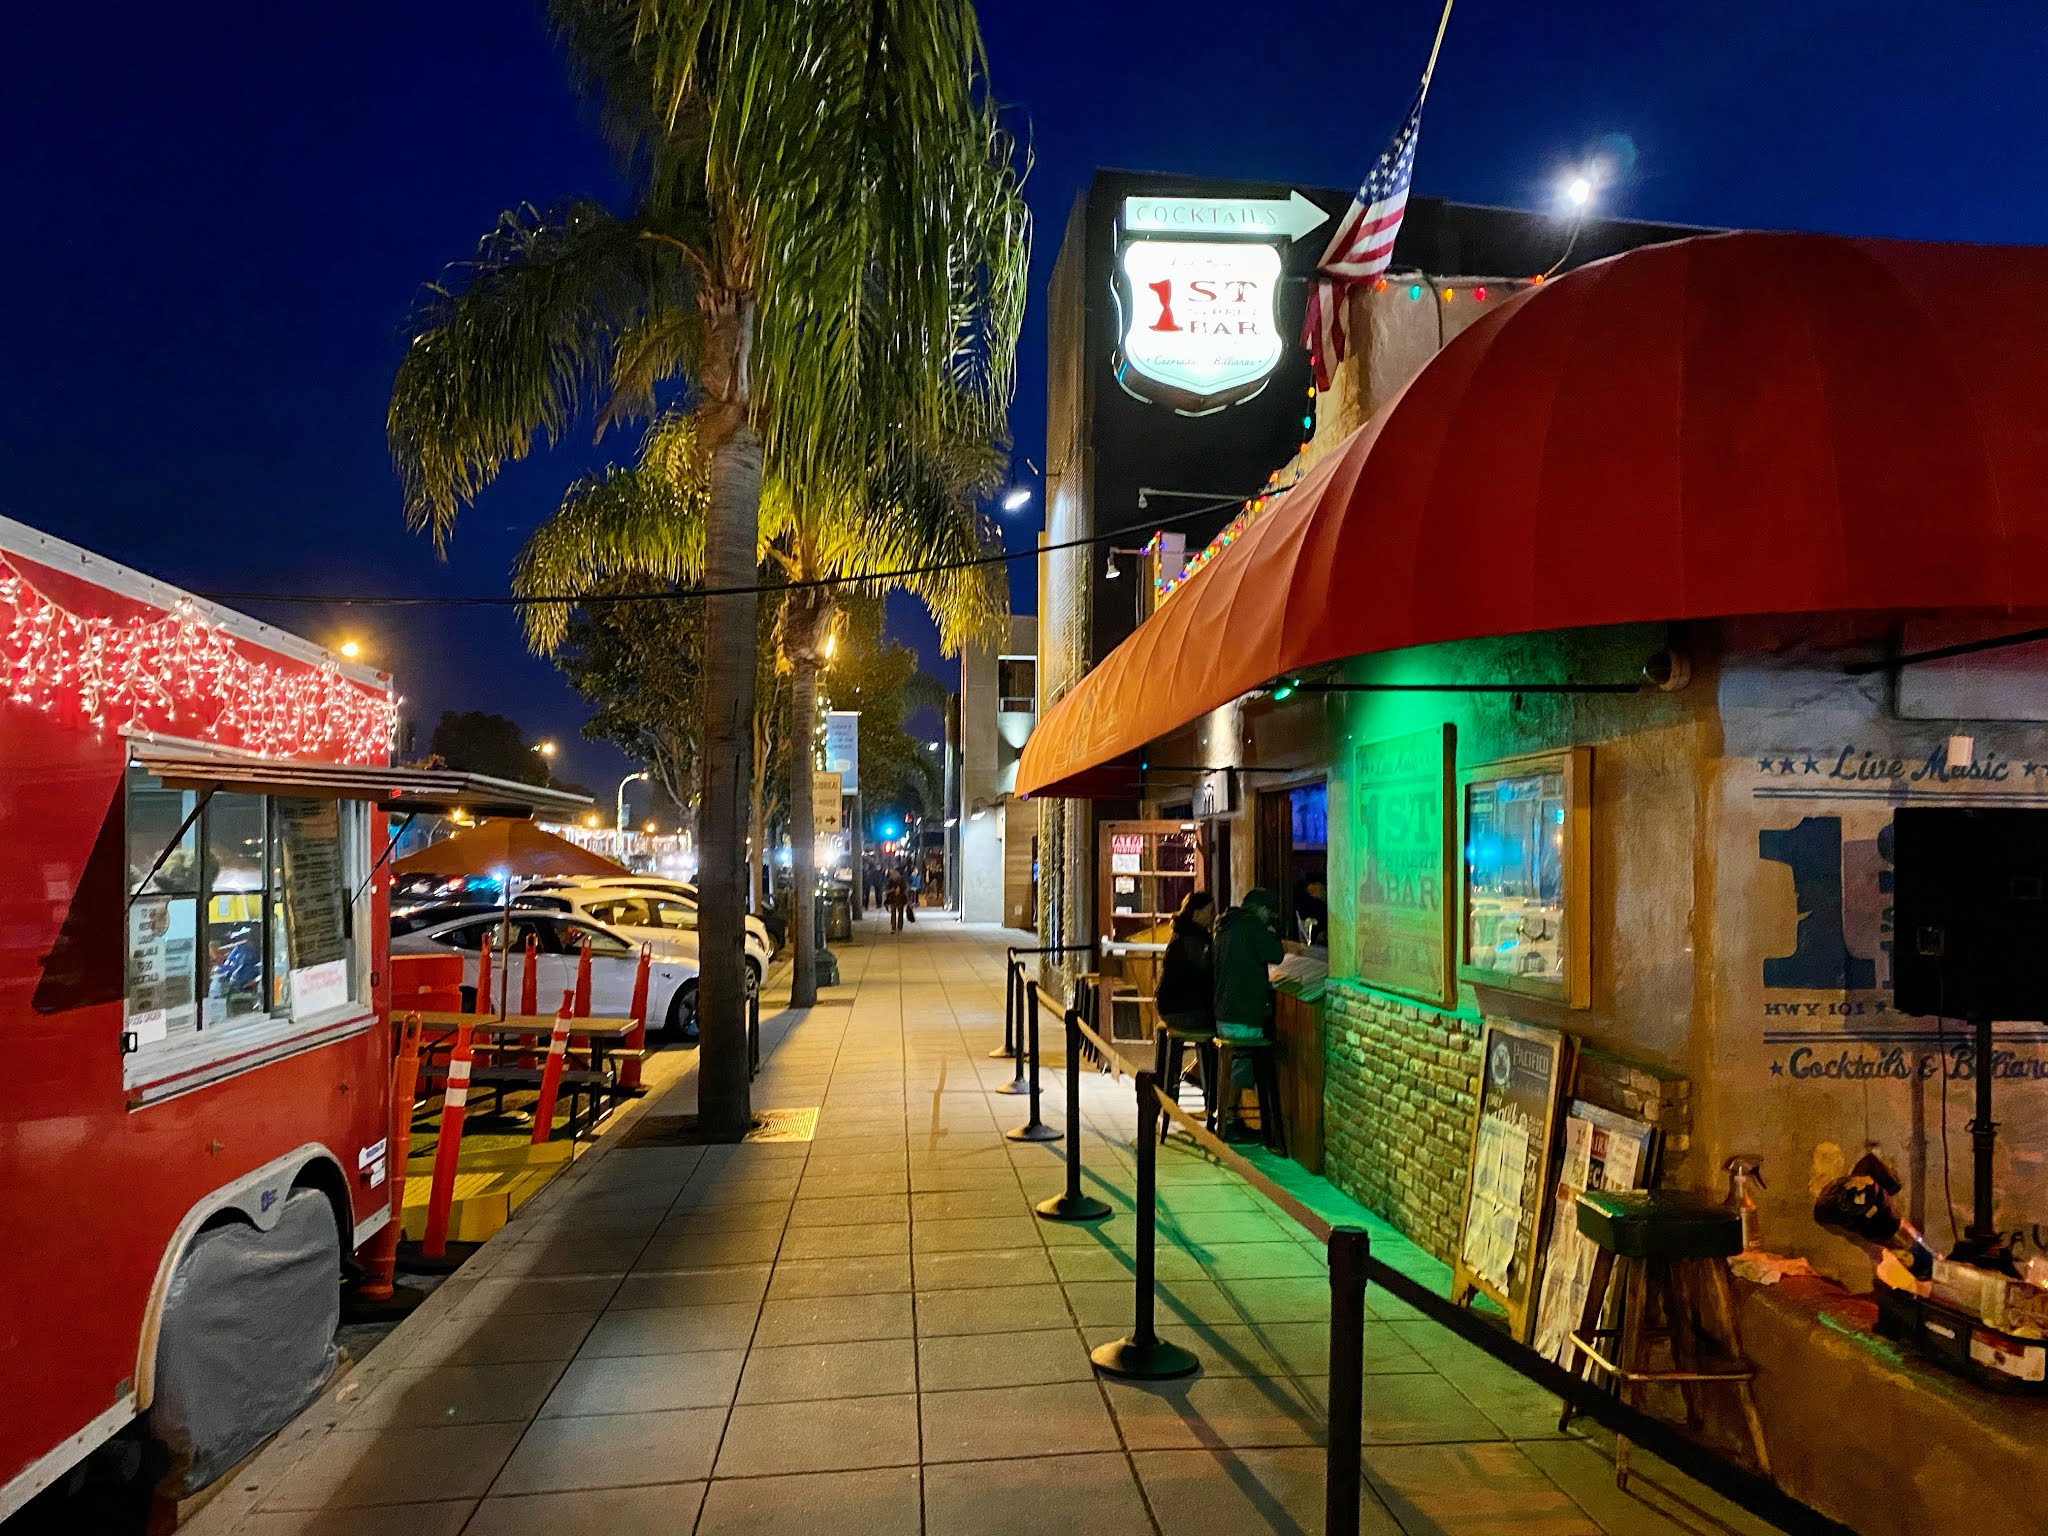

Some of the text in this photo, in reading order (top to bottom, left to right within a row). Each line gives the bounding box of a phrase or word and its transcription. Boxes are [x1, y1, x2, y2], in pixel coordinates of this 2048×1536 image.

[1136, 206, 1278, 226] COCKTAILS
[1828, 743, 2010, 783] Live Music
[1114, 835, 1141, 846] ATM
[1385, 872, 1439, 912] BAR
[1764, 1002, 1865, 1017] HWY 101
[1789, 1046, 1912, 1080] Cocktails
[1917, 1054, 1940, 1080] &
